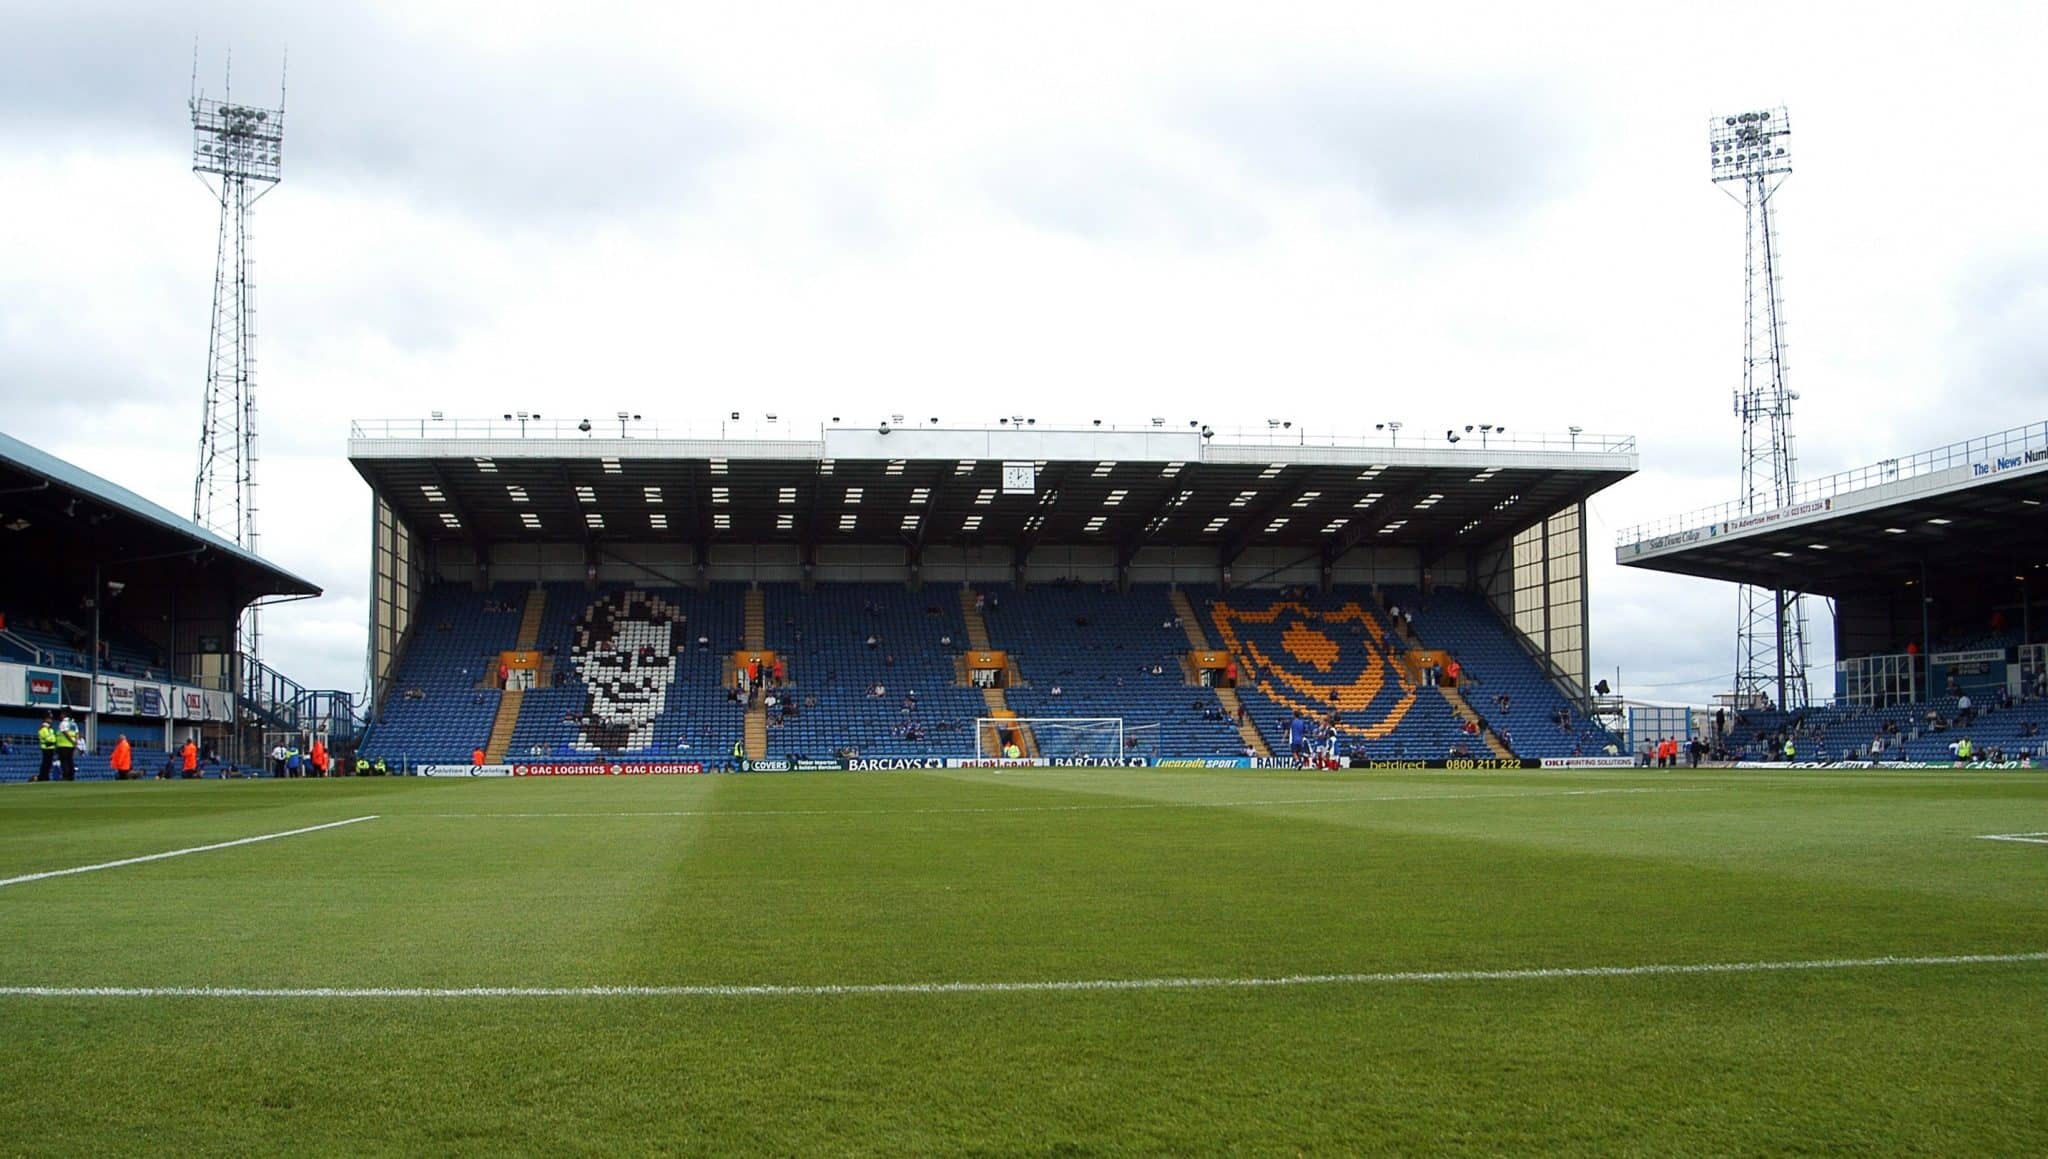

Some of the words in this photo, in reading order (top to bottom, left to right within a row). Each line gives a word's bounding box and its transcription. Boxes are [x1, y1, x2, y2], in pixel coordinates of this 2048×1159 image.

[1973, 463, 1989, 476] The
[1997, 456, 2021, 471] News
[1739, 516, 1765, 528] Advertise
[1766, 513, 1780, 522] Here
[186, 693, 201, 709] OKI
[754, 760, 787, 769] COVERS
[848, 759, 922, 770] BARCLAYS
[1055, 758, 1125, 767] BARCLAYS
[1155, 758, 1205, 768] Lucozade
[1257, 757, 1304, 769] RAINHA
[1370, 760, 1427, 769] betdirect
[1446, 759, 1474, 769] 0800
[1478, 759, 1497, 769] 211
[1500, 759, 1521, 769] 222
[531, 766, 552, 775] GAC
[555, 766, 605, 775] LOGISTICS
[625, 765, 646, 774] GAC
[649, 765, 699, 774] LOGISTICS
